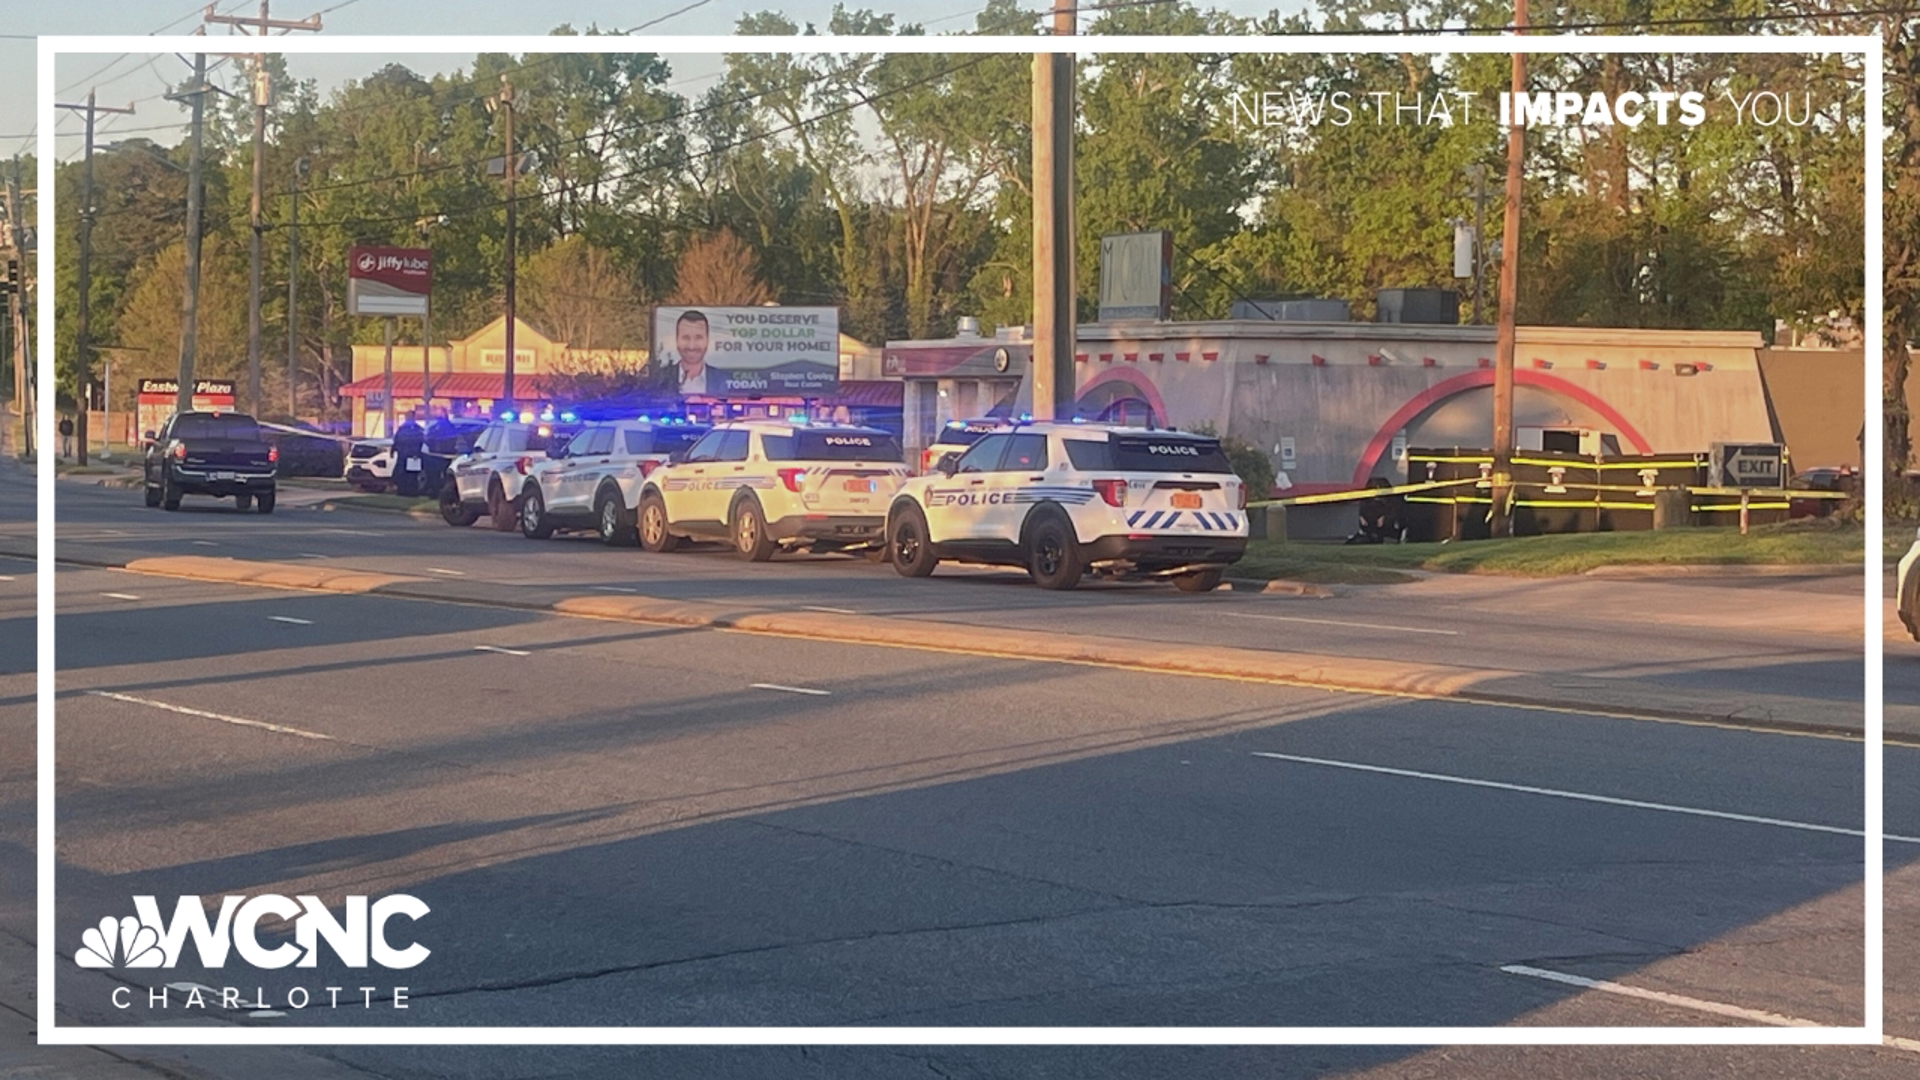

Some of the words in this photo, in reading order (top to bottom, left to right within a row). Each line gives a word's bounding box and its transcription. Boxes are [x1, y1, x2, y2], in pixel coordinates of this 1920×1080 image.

[726, 314, 755, 325] YOU
[758, 314, 820, 325] DESERVE
[730, 328, 758, 338] TOP
[761, 328, 815, 338] DOLLAR
[715, 341, 742, 352] FOR
[746, 341, 783, 352] YOUR
[787, 341, 831, 352] HOME!
[733, 371, 760, 381] CALL
[197, 381, 232, 393] Plaza
[726, 379, 768, 390] TODAY!
[826, 437, 871, 447] POLICE
[1148, 445, 1200, 456] POLICE
[1738, 460, 1774, 474] EXIT
[945, 492, 1014, 506] POLICE
